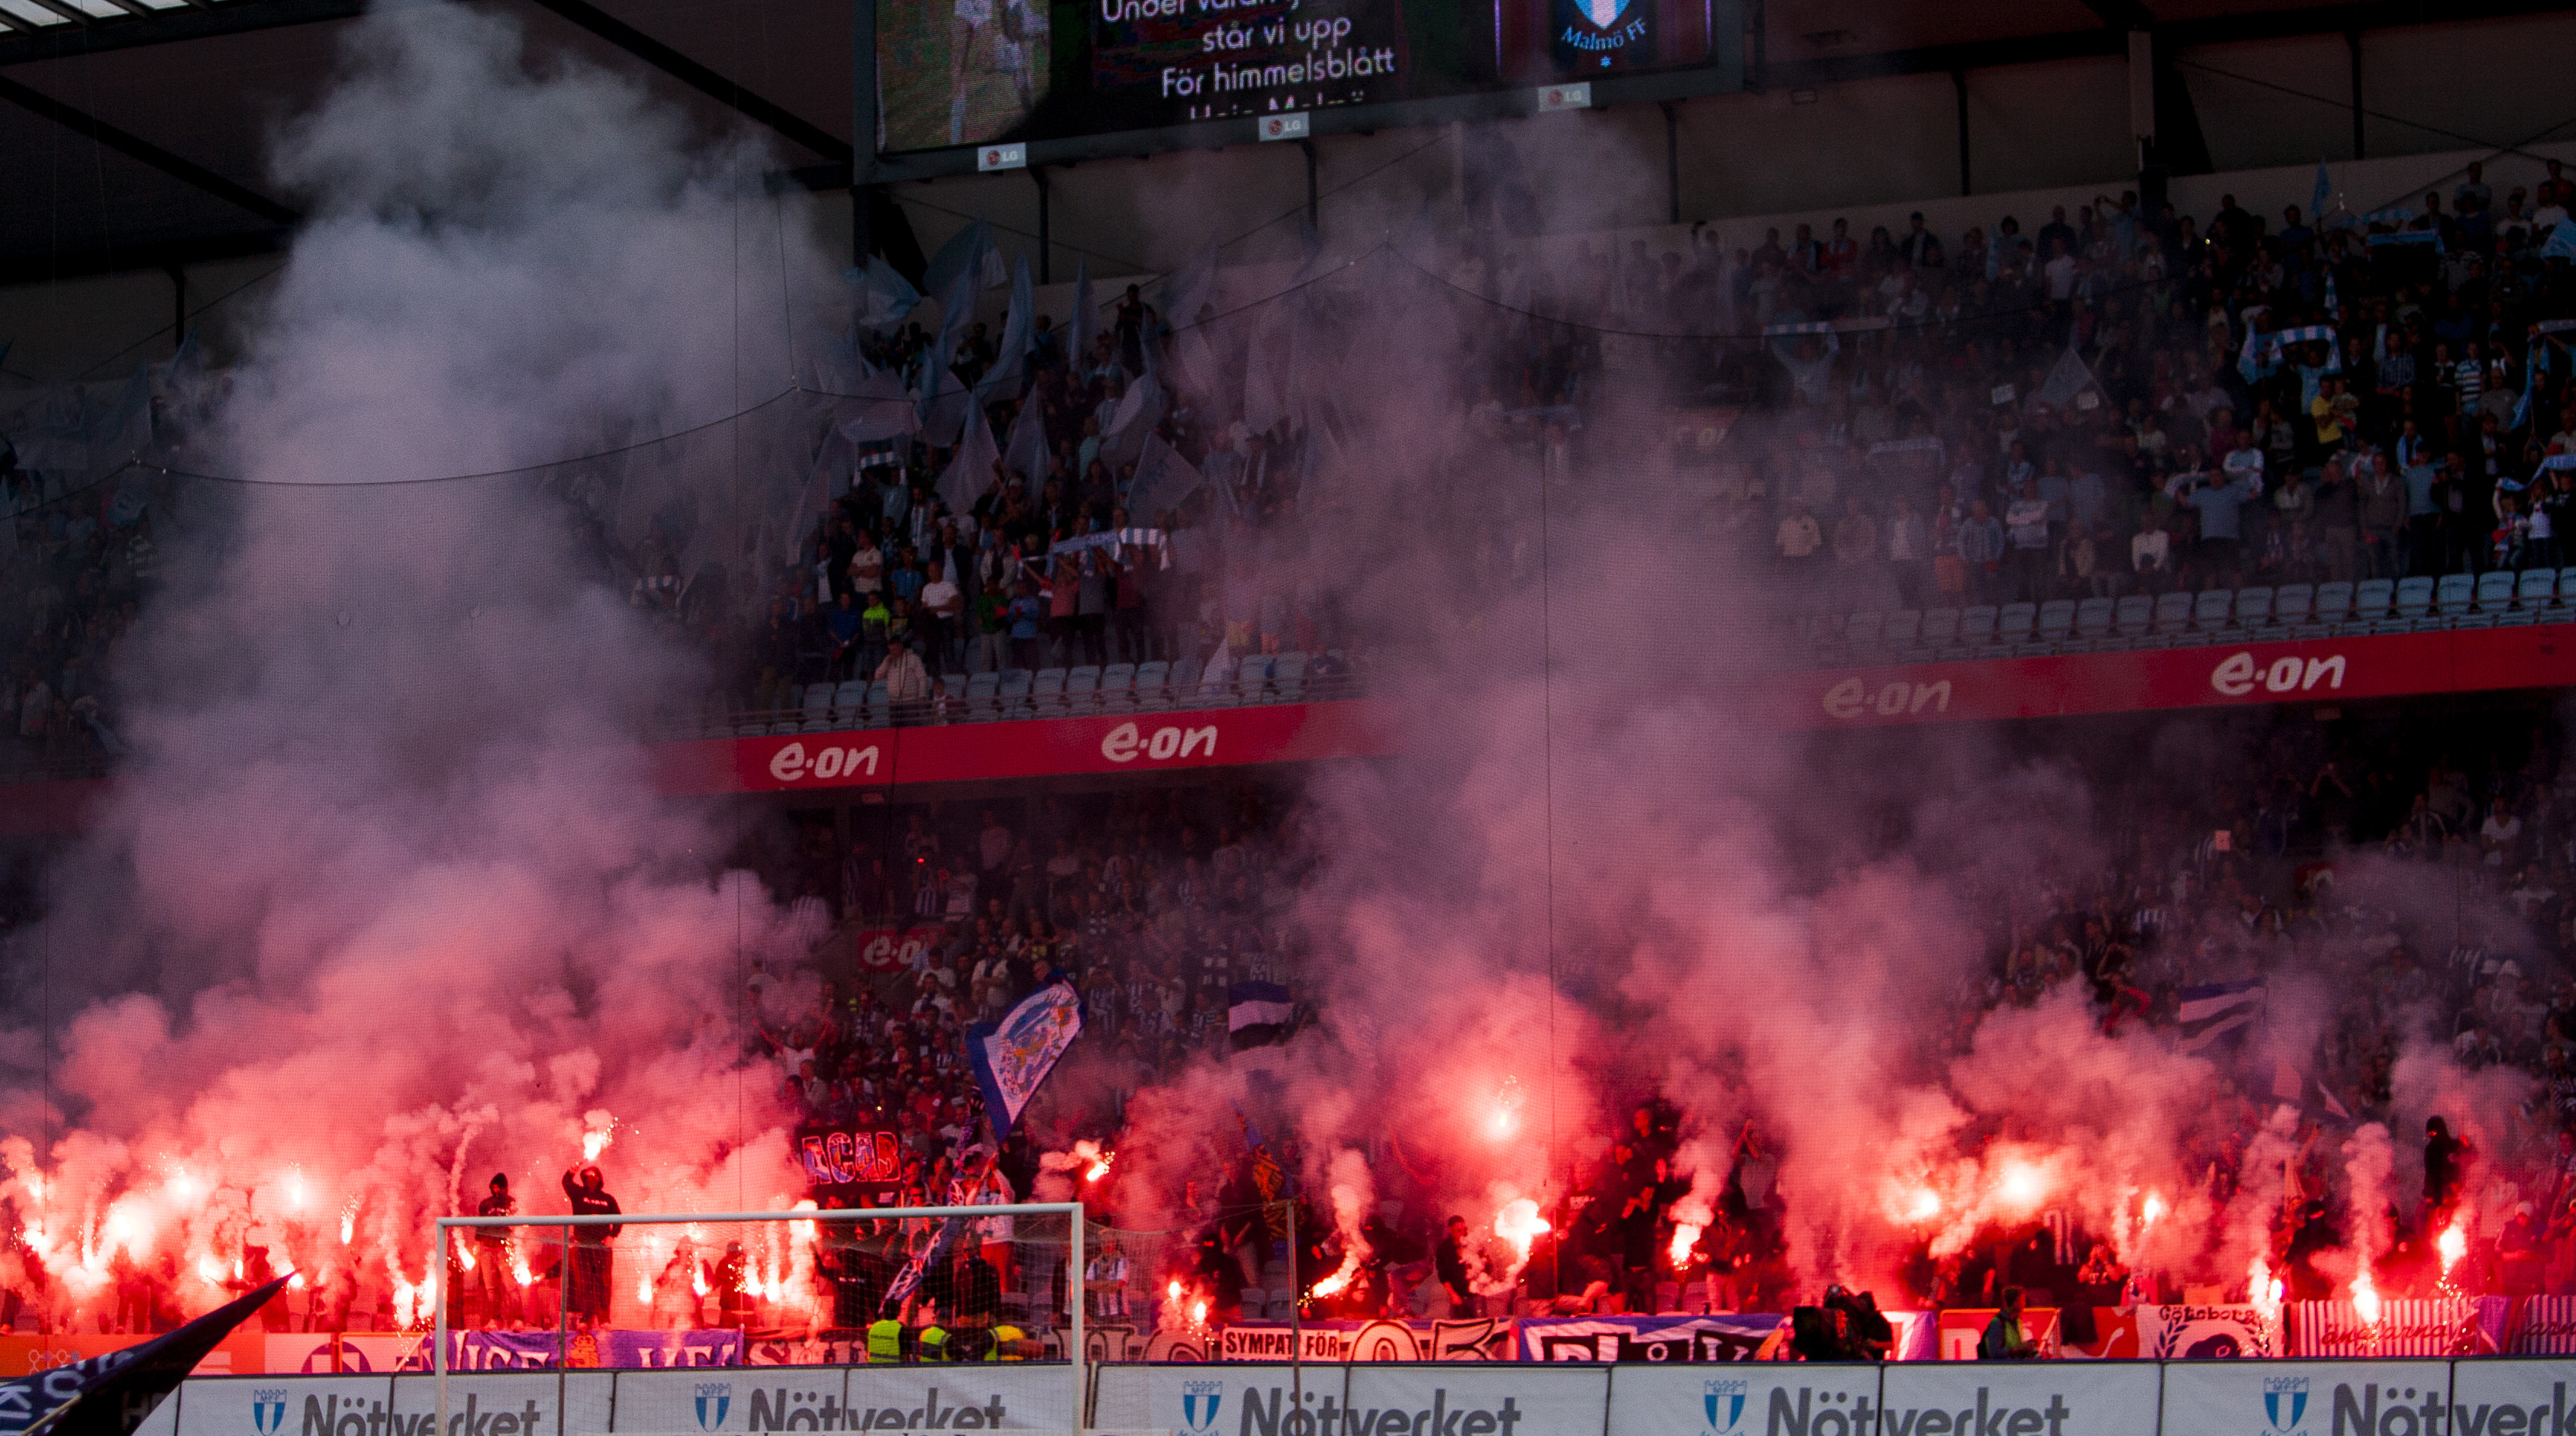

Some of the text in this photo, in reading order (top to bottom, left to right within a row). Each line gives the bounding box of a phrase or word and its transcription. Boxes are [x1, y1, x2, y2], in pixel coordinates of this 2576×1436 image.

[1203, 16, 1352, 52] står vi upp
[1561, 18, 1646, 50] Malmö FF
[1162, 47, 1395, 98] För himmelsblått
[1565, 89, 1583, 102] LG
[1284, 119, 1301, 131] LG
[1001, 150, 1019, 163] LG
[801, 1131, 901, 1185] ACAB
[1226, 1332, 1301, 1354] SYMPAT
[1306, 1331, 1338, 1357] FÖR
